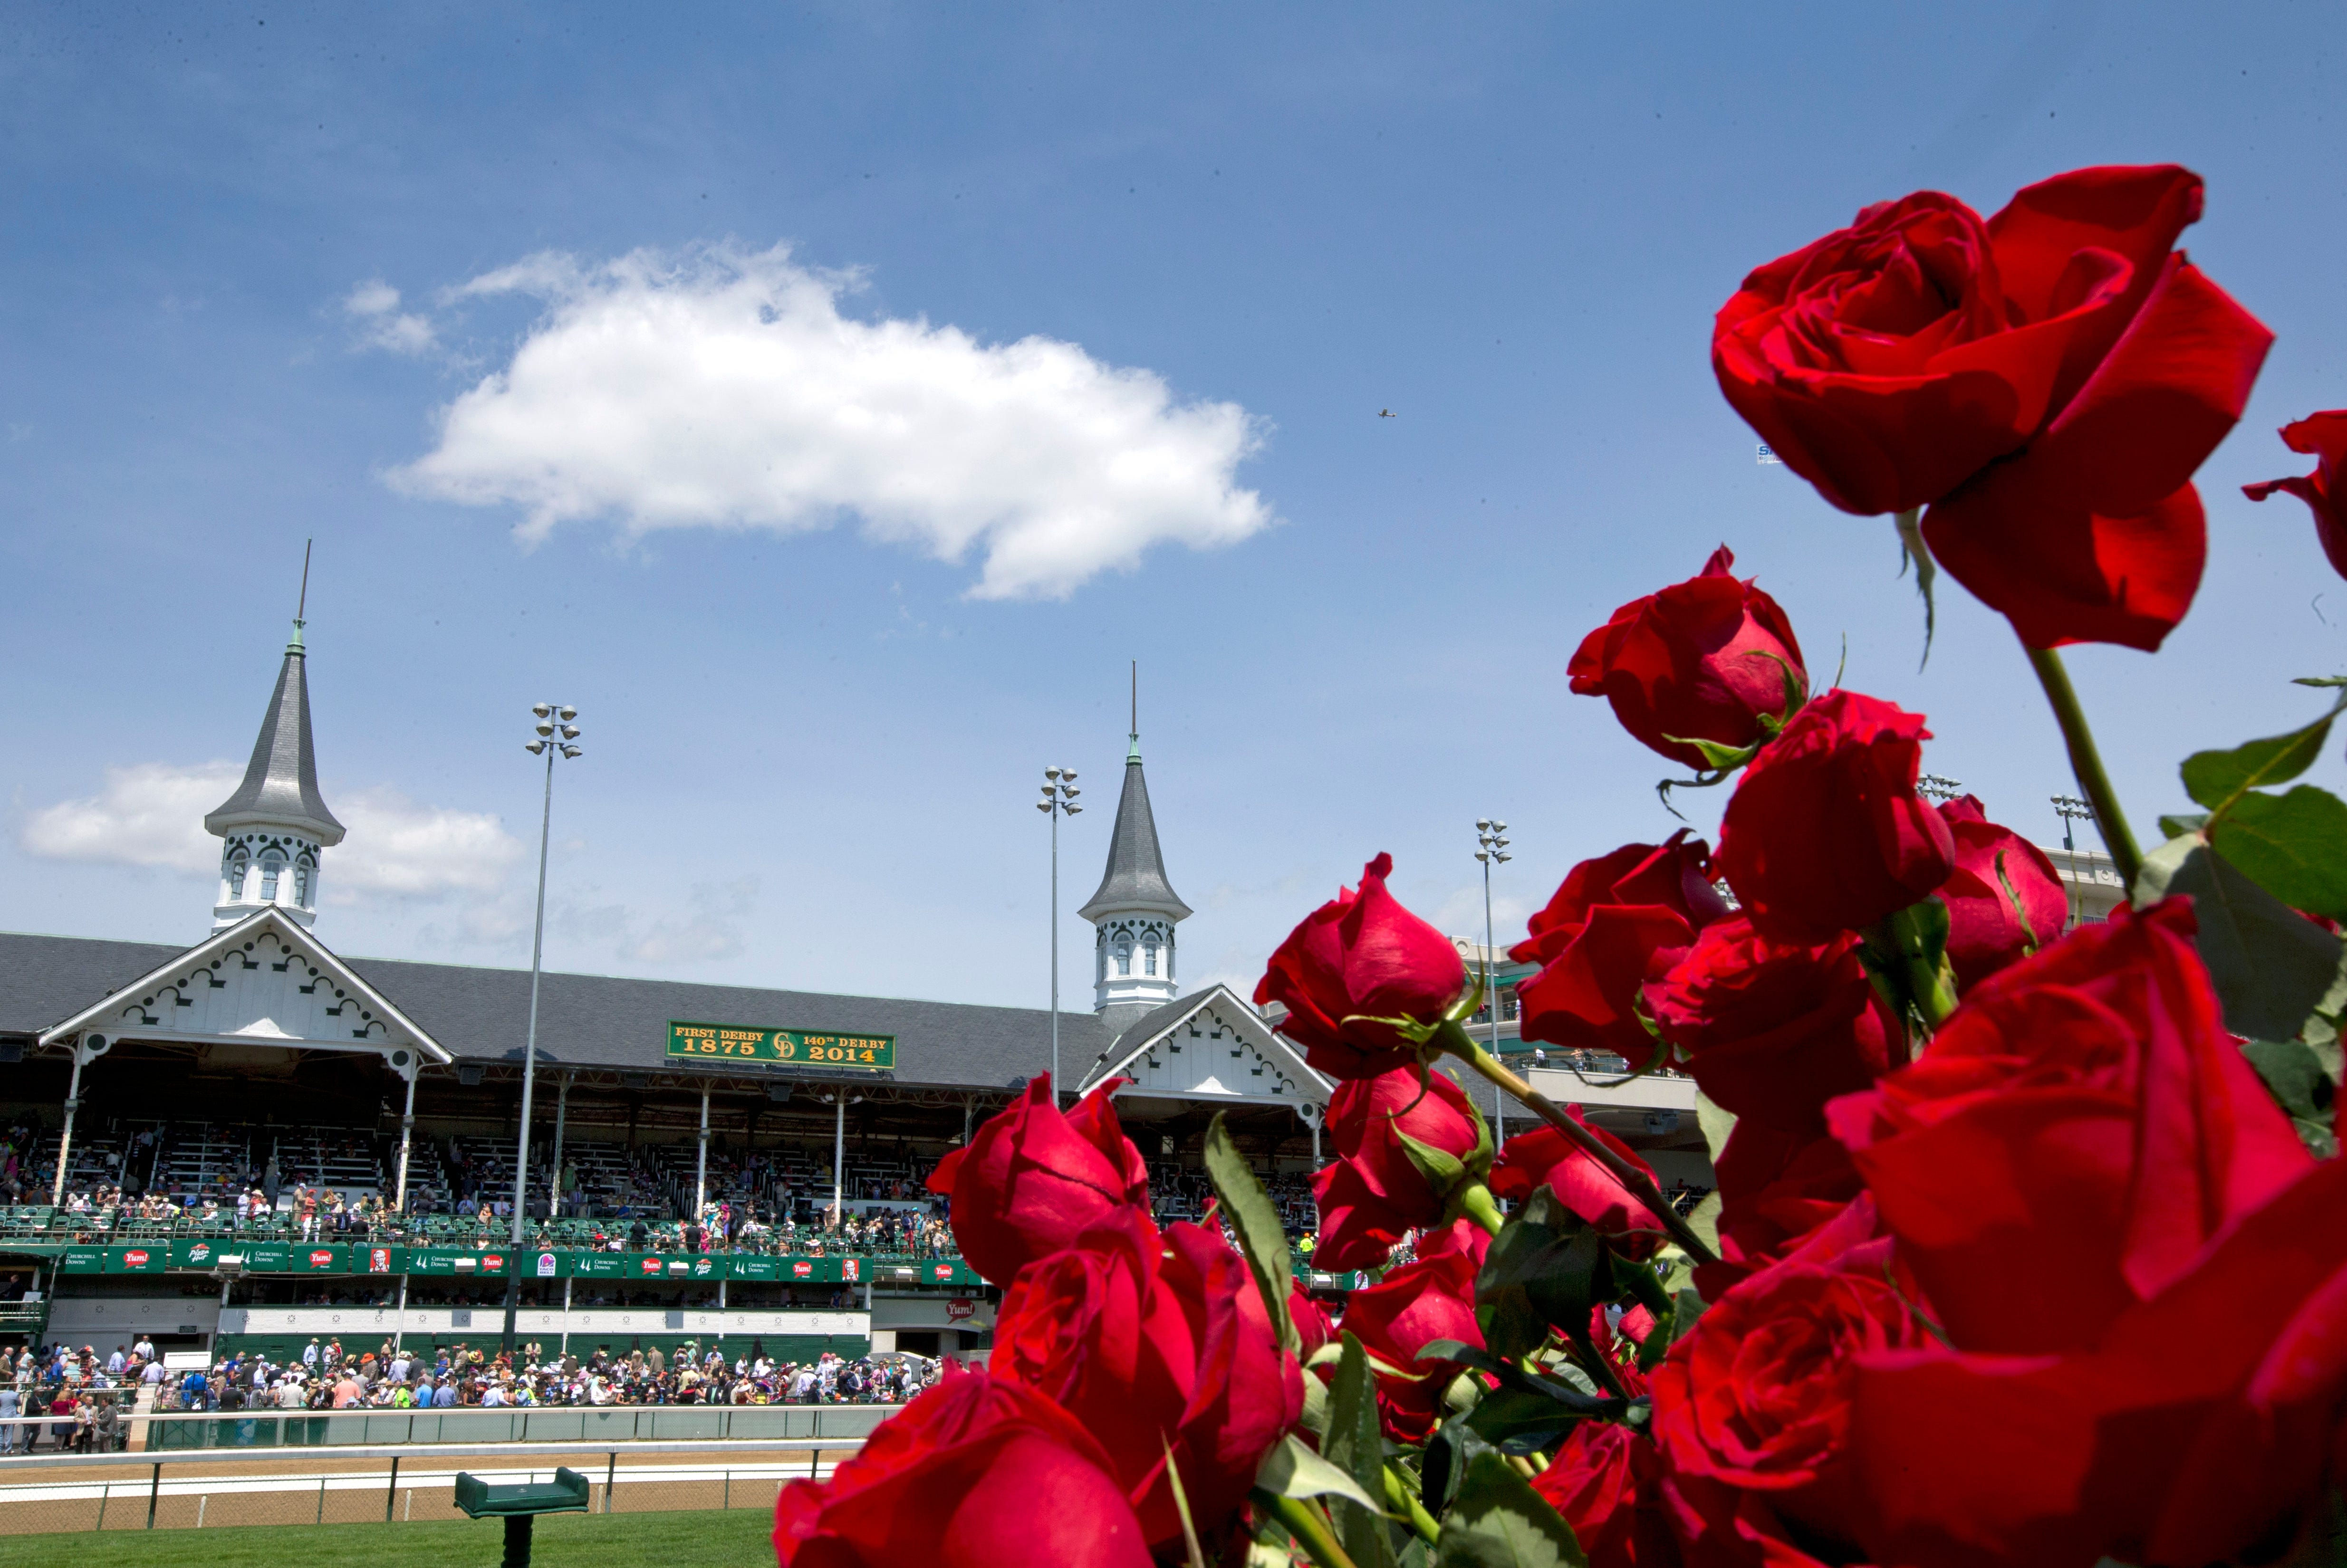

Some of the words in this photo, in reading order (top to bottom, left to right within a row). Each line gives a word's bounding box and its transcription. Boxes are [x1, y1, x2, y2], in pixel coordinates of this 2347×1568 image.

[675, 1027, 716, 1038] FIRST
[720, 1030, 764, 1042] DERBY
[684, 1038, 755, 1055] 1875
[838, 1038, 886, 1049] DERBY
[809, 1047, 875, 1063] 2014
[126, 1253, 148, 1262] Yum!
[311, 1253, 332, 1262] Yum!
[483, 1258, 502, 1266] Yum!
[643, 1261, 661, 1269] Yum!
[948, 1304, 973, 1314] Yum!
